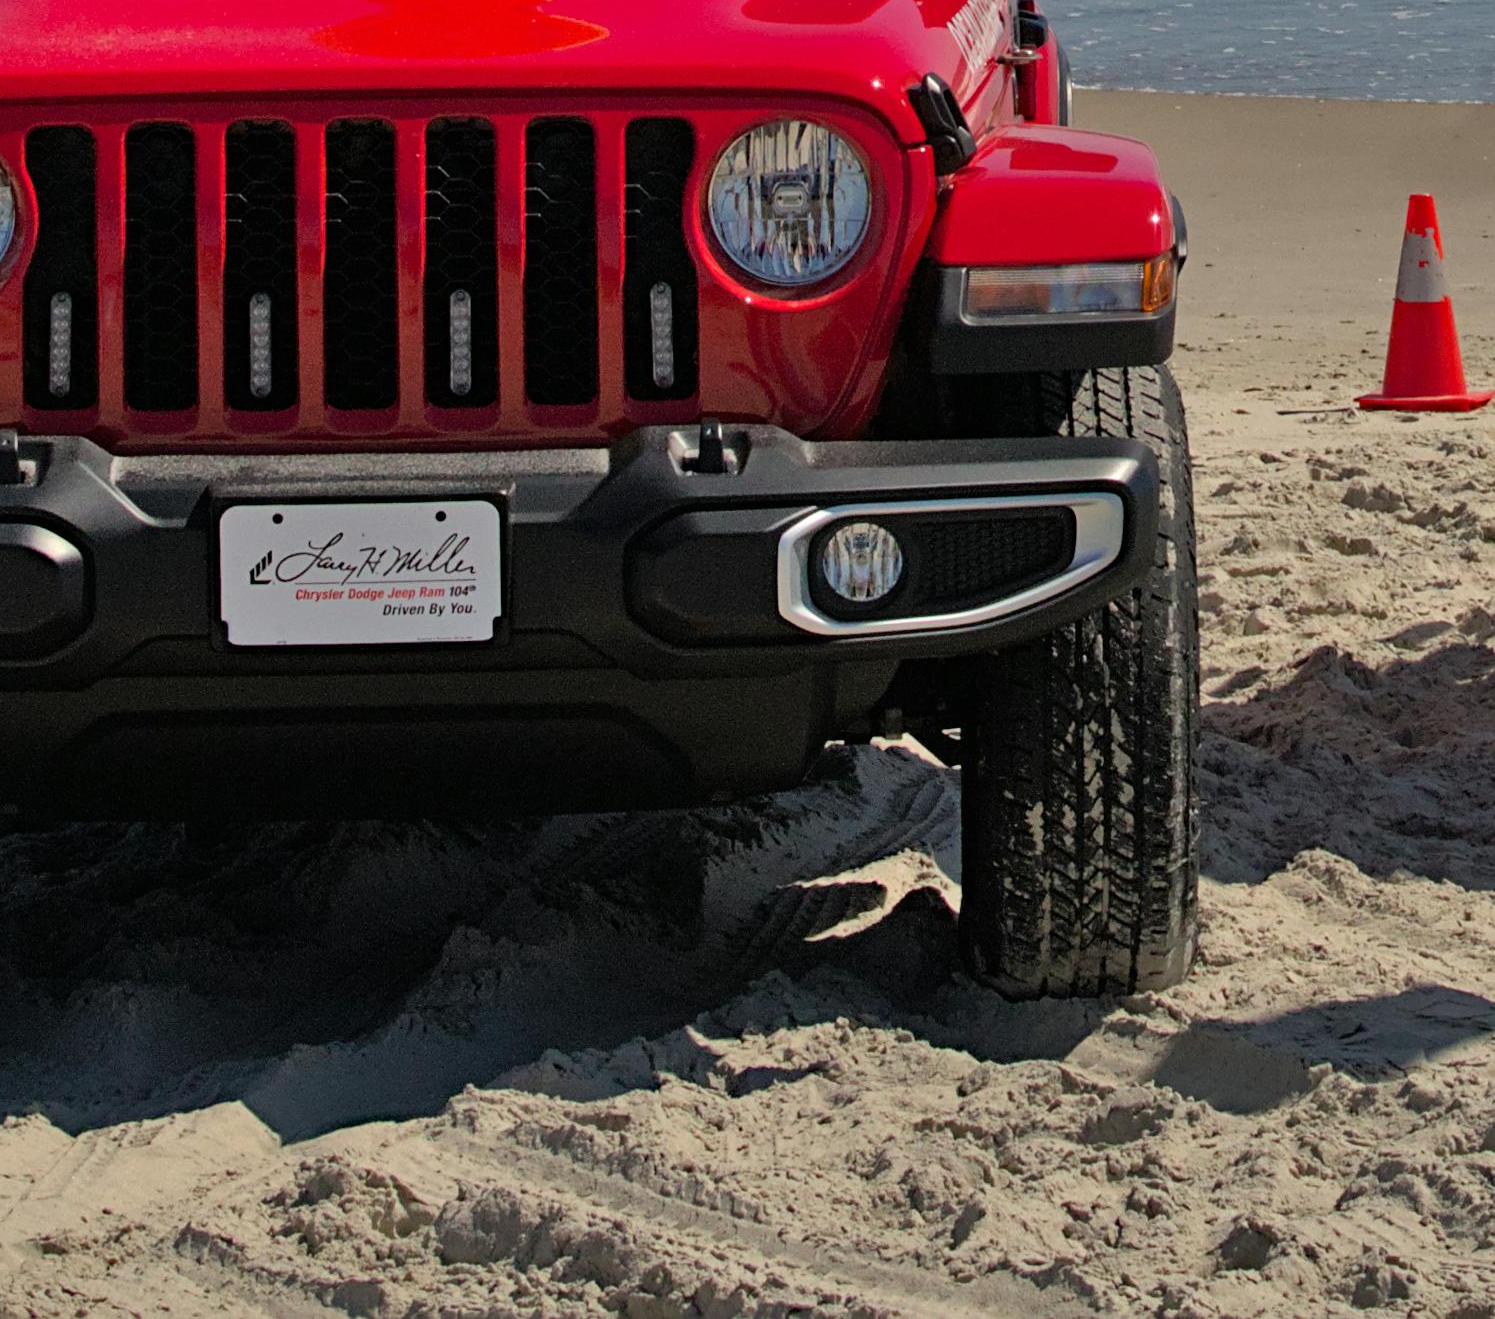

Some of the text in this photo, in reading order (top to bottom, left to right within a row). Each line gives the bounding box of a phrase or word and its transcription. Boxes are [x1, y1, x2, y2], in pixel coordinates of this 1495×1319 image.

[275, 532, 358, 586] Larry
[383, 533, 477, 577] Miller
[295, 588, 344, 601] Chrysler
[348, 588, 385, 600] Dodge
[387, 587, 416, 600] Jeep
[419, 586, 445, 597] Ram
[382, 604, 426, 616] Driven
[428, 604, 446, 617] By
